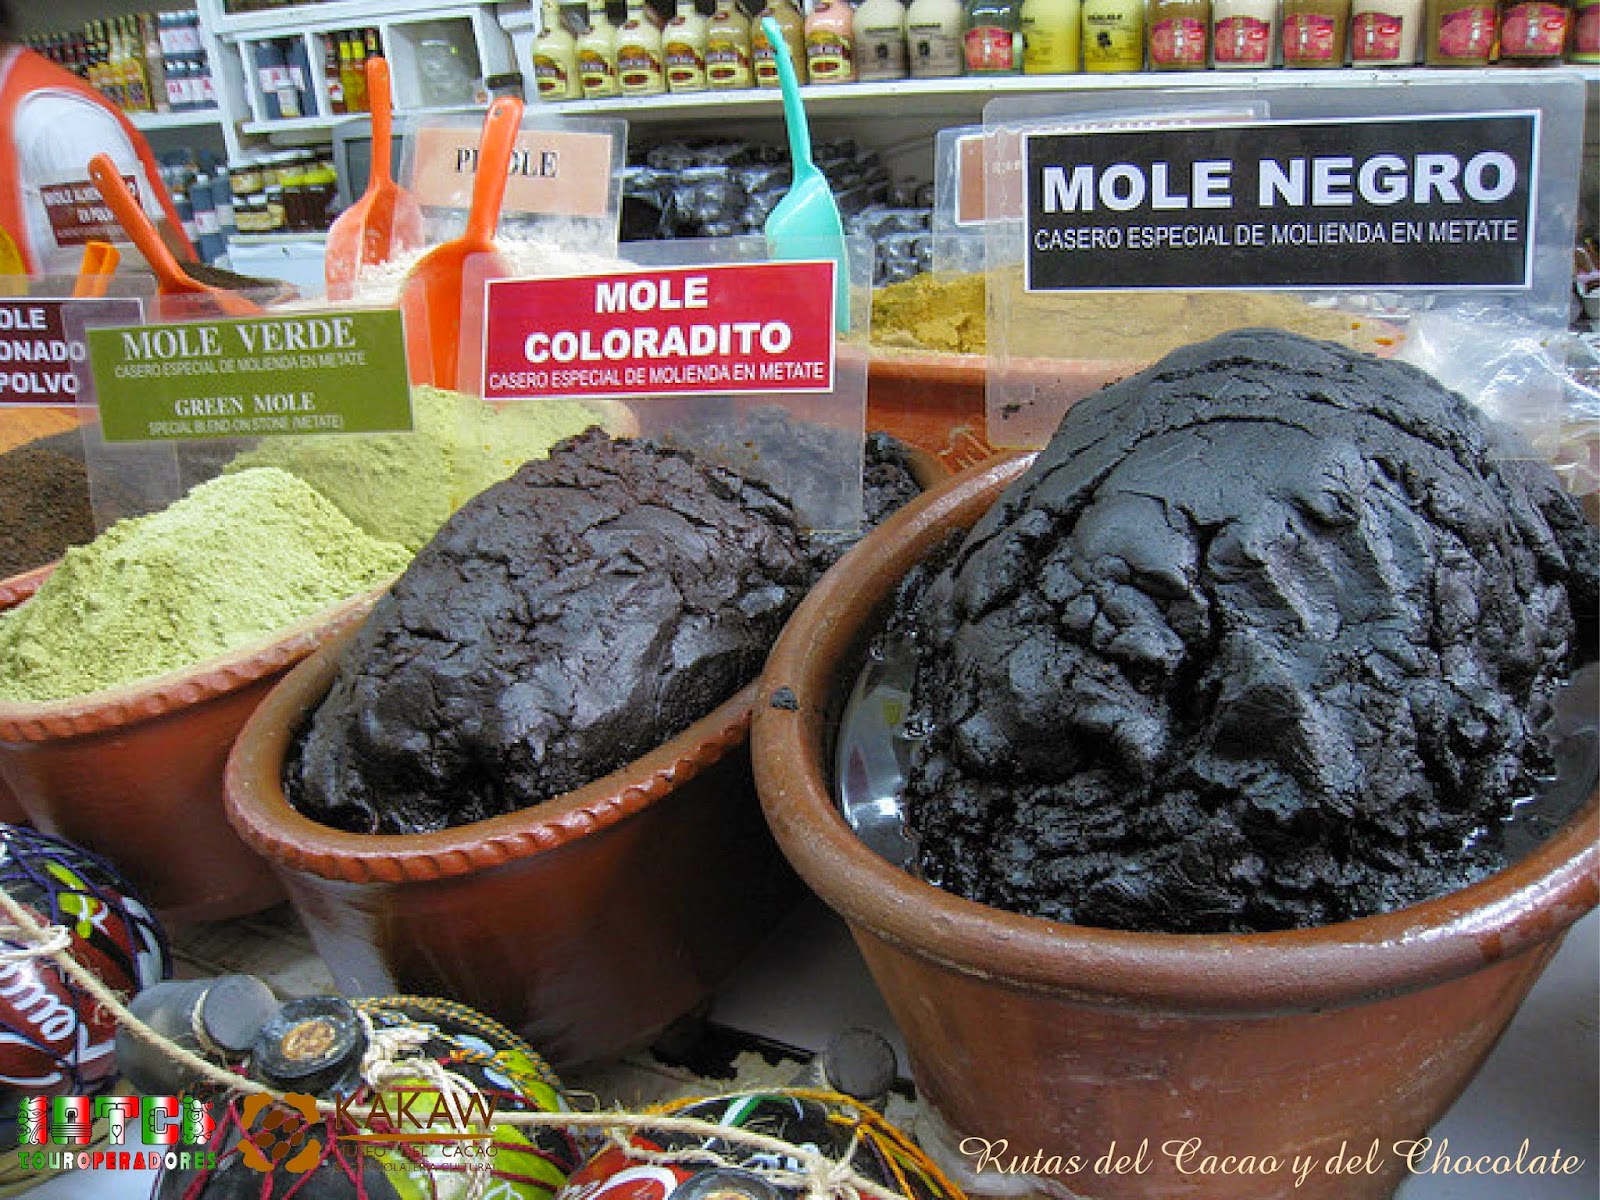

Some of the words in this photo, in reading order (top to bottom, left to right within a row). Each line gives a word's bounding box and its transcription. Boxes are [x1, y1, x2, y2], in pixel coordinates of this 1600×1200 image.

[457, 149, 557, 177] PIOLE
[1041, 159, 1233, 213] MOLE
[1258, 151, 1517, 208] NEGRO
[1034, 227, 1122, 251] CASERO
[1126, 224, 1231, 249] ESPECIAL
[1234, 223, 1265, 247] DE
[1271, 221, 1386, 246] MOLIENDA
[1391, 221, 1424, 244] EN
[1428, 219, 1518, 244] METATE
[594, 277, 709, 313] MOLE
[122, 325, 222, 361] MOLE
[235, 316, 356, 353] VERDE
[524, 320, 793, 363] COLORADITO
[115, 363, 161, 378] CASERO
[164, 360, 219, 376] ESPECIAL
[221, 359, 235, 373] DE
[318, 351, 367, 368] METATE
[490, 371, 550, 390] CASERO
[552, 367, 621, 387] ESPECIAL
[624, 367, 646, 385] DE
[650, 363, 731, 385] MOLIENDA
[733, 363, 755, 381] EN
[759, 361, 826, 380] METATE
[174, 397, 243, 416] GREEN
[254, 391, 316, 414] MOLE
